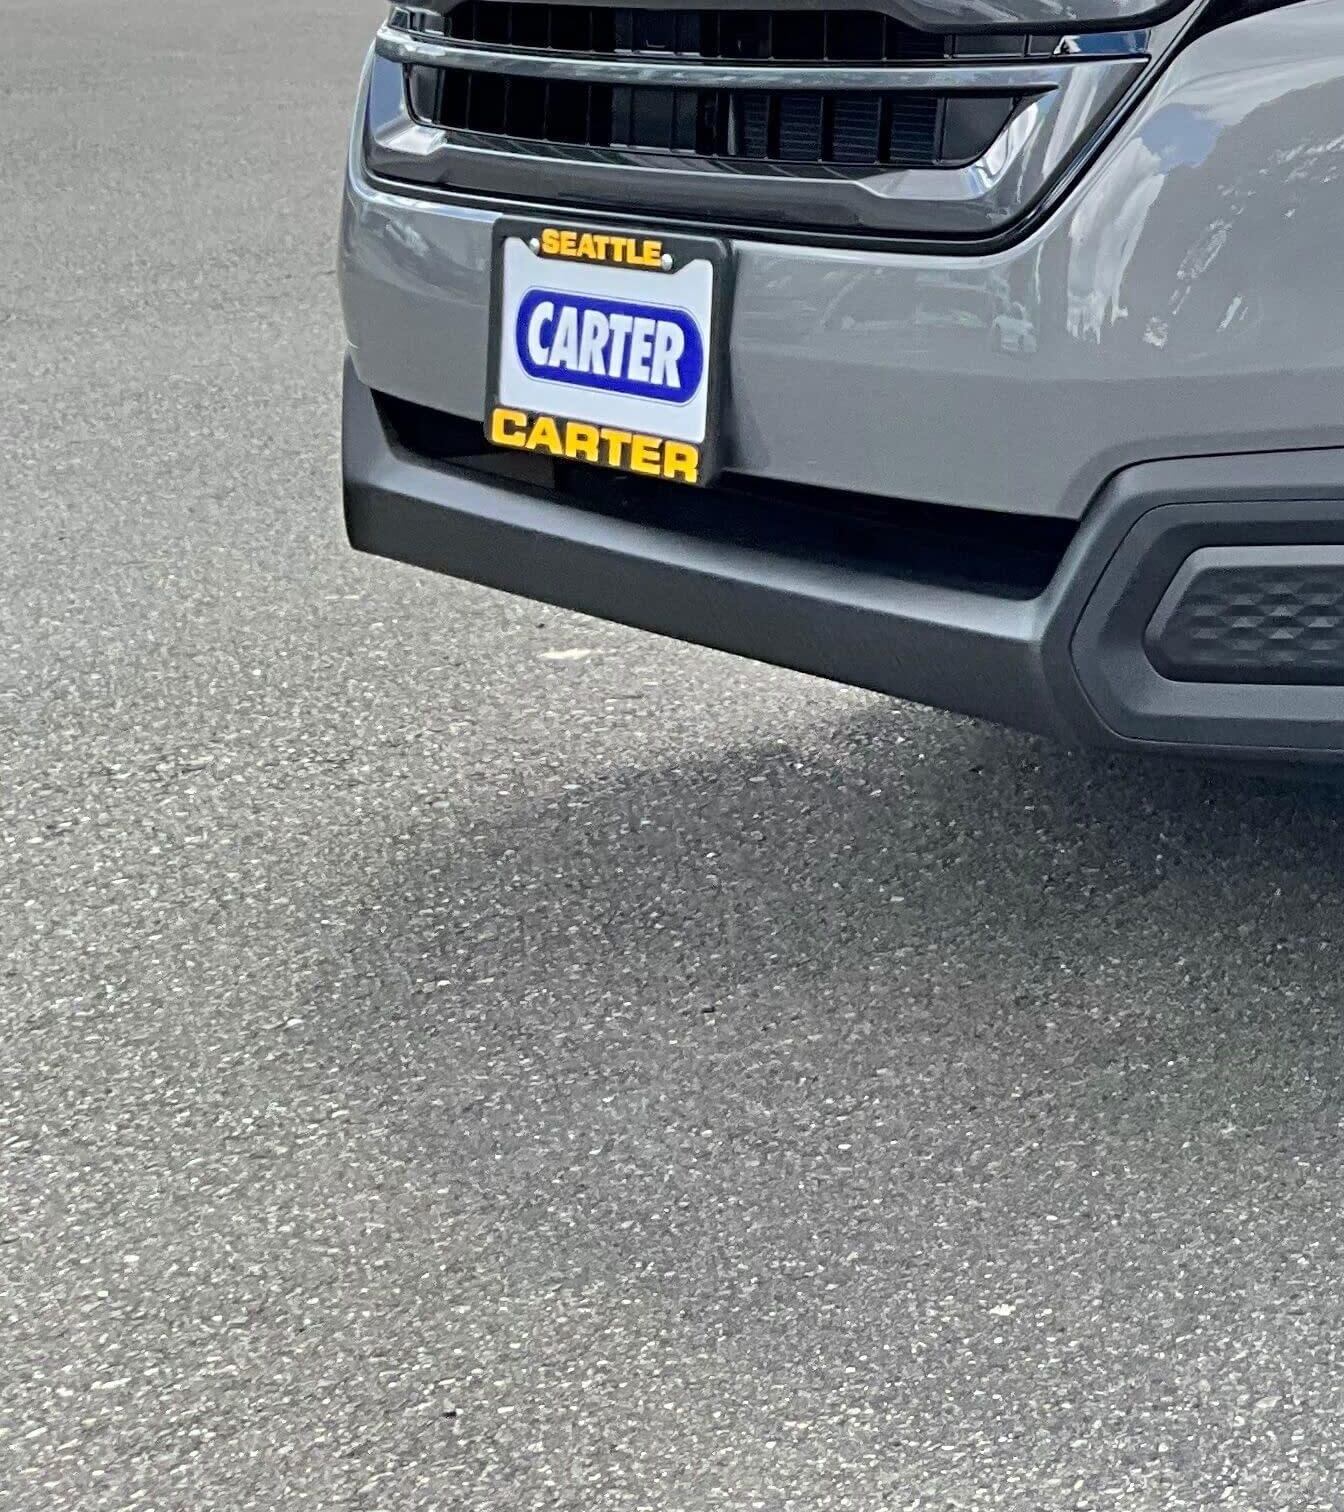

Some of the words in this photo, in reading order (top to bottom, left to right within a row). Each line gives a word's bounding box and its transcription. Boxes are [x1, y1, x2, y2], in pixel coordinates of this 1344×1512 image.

[541, 228, 663, 267] SEATTLE
[527, 300, 686, 389] CARTER
[491, 407, 700, 484] CARTER
